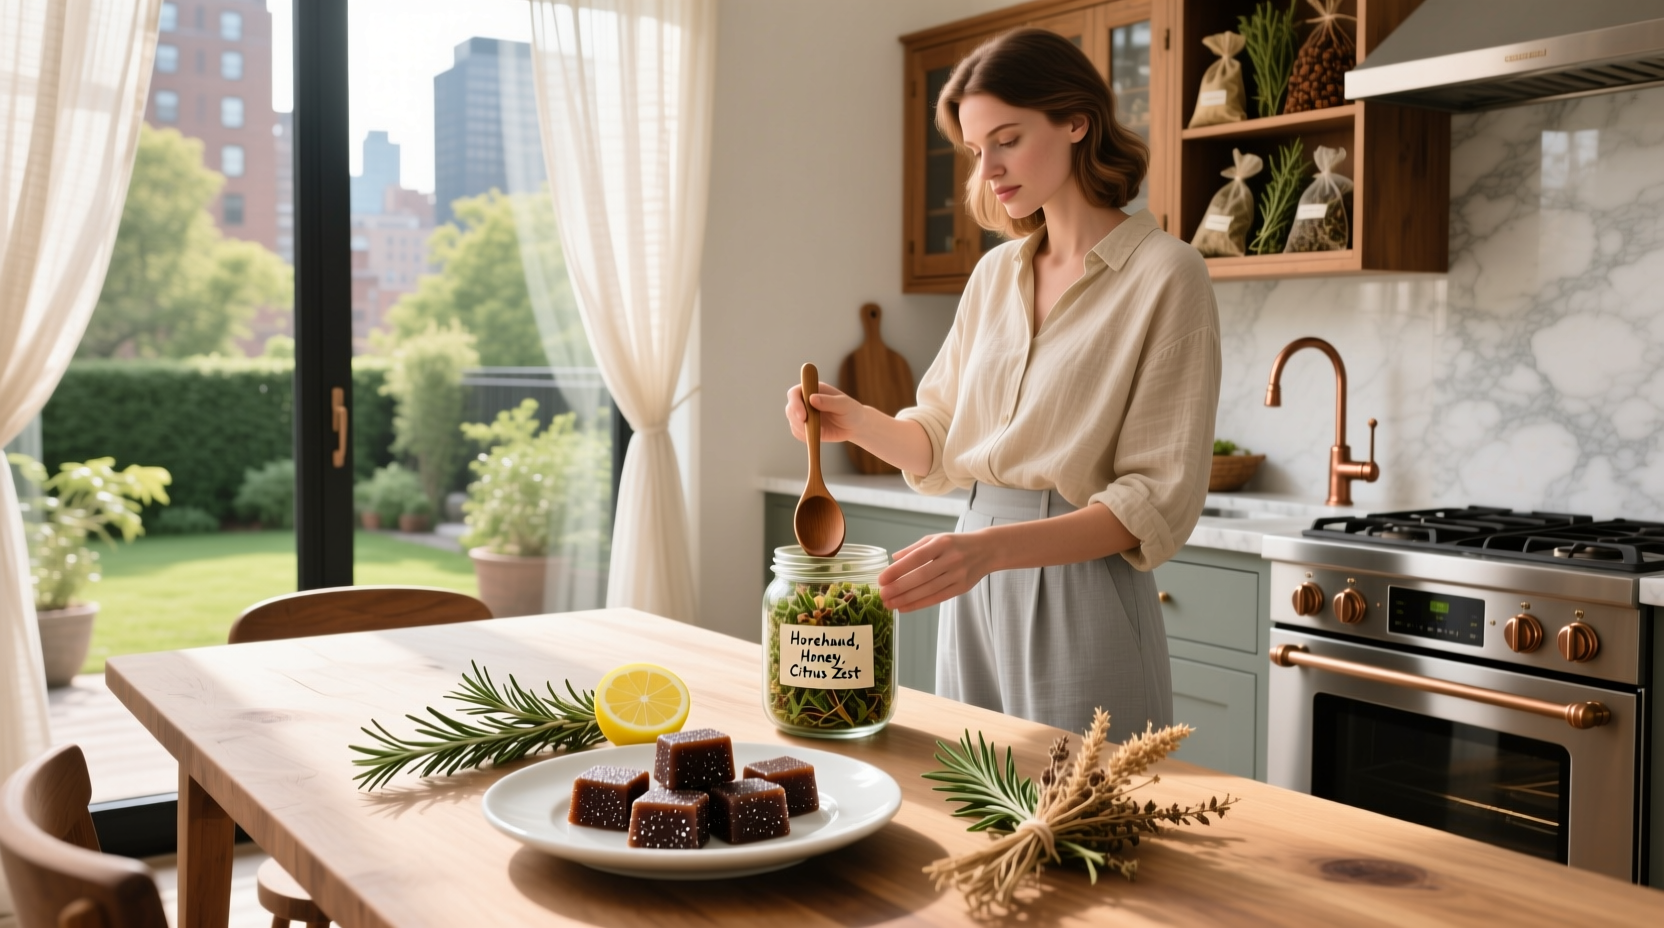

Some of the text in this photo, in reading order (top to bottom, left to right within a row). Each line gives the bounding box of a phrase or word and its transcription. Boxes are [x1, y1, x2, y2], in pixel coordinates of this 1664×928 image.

[801, 649, 845, 667] Honey,
[790, 664, 862, 679] Citrus Zest
